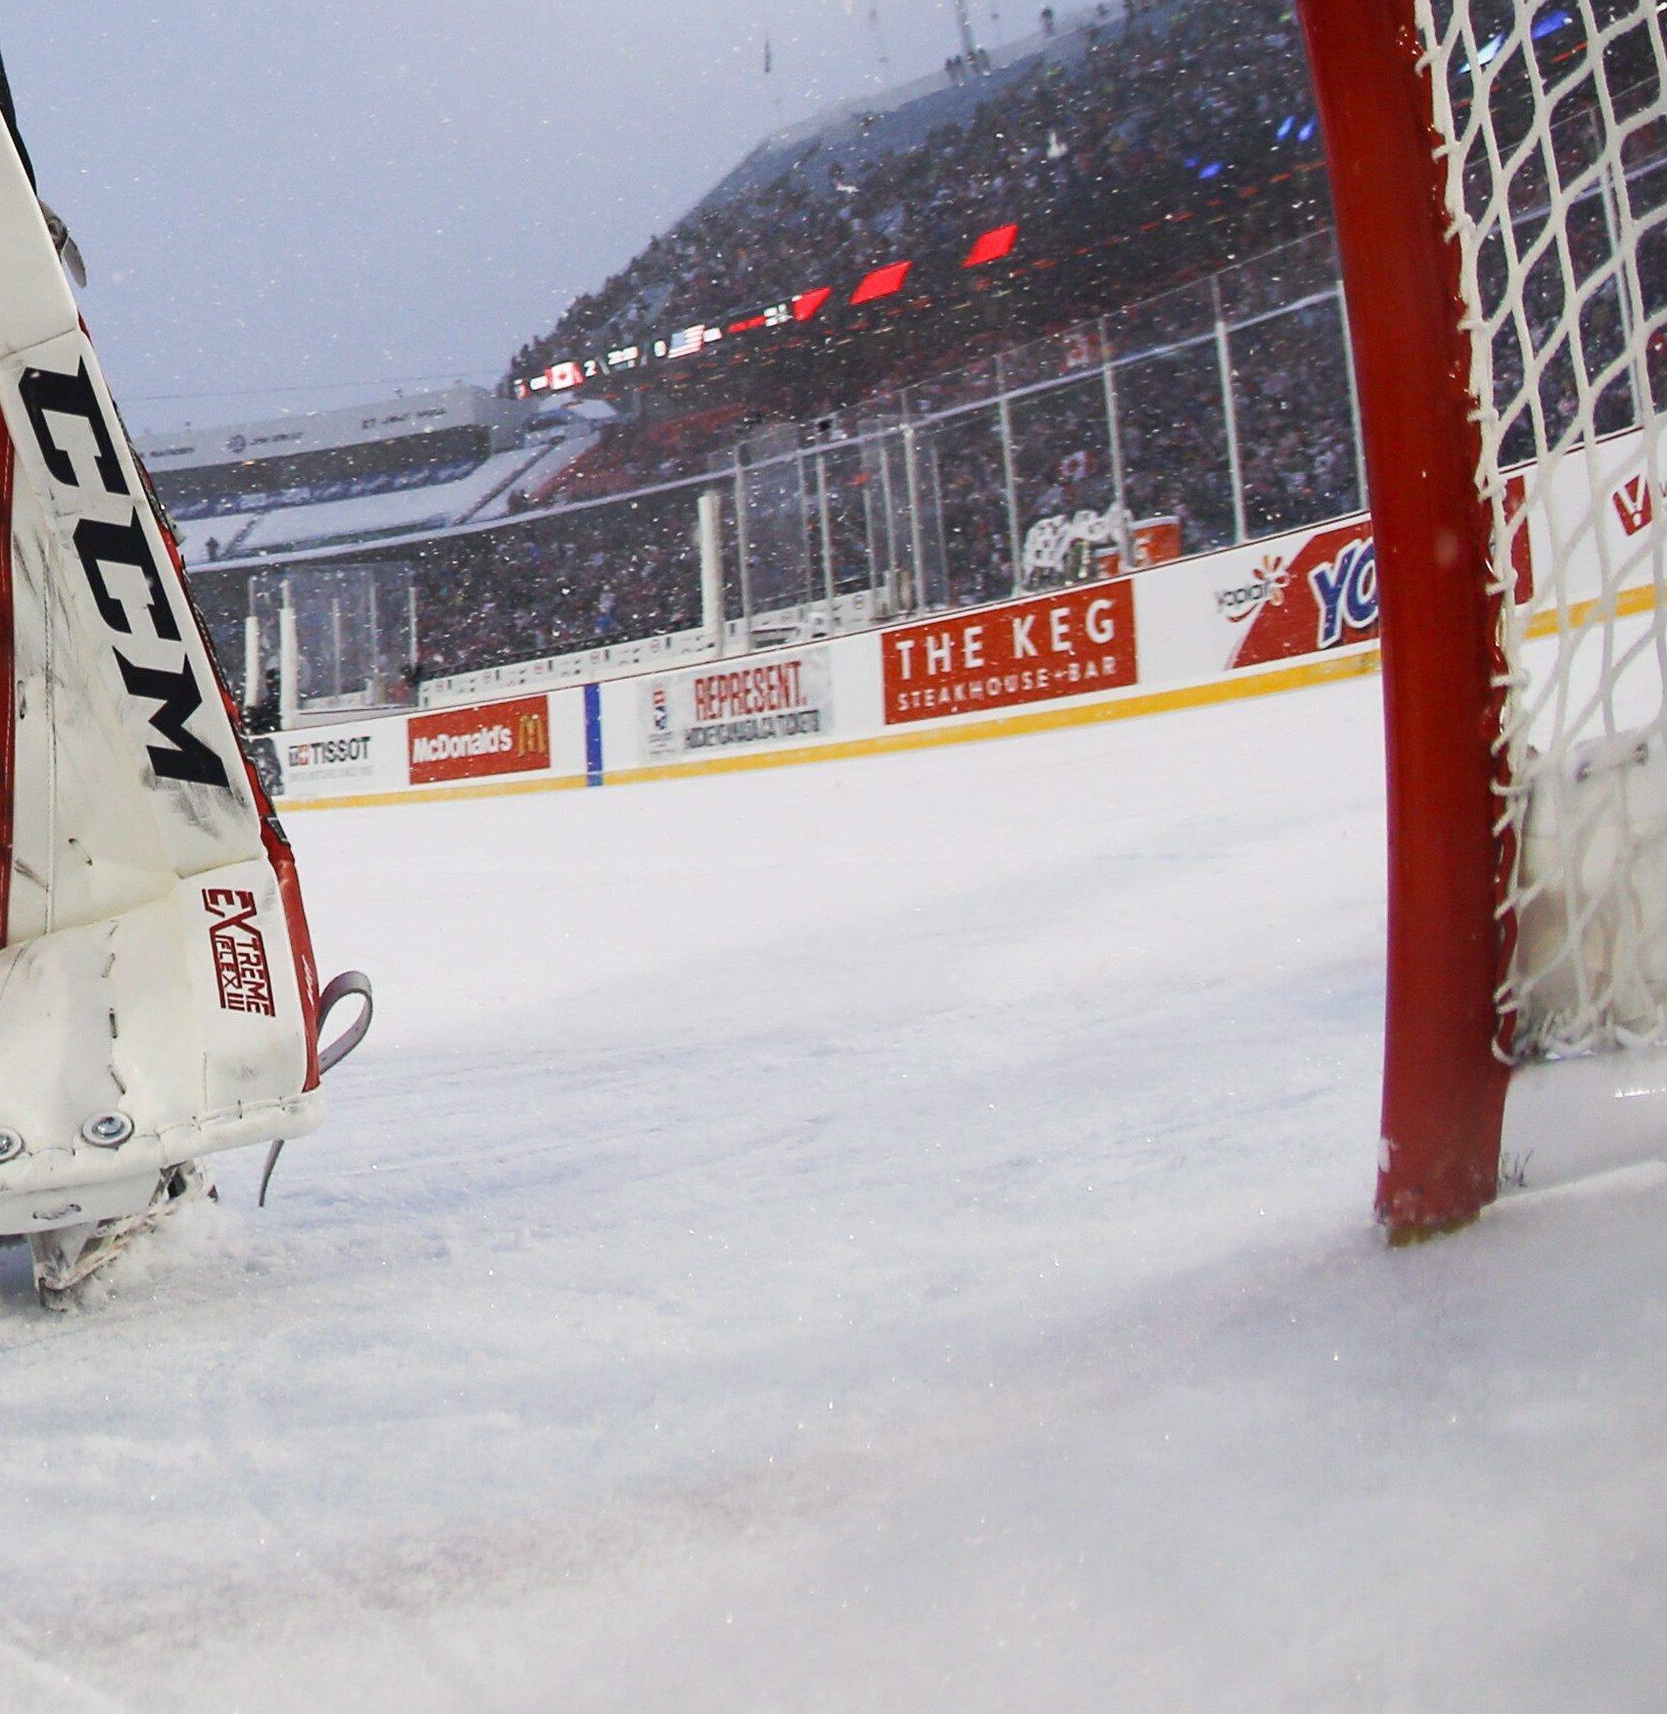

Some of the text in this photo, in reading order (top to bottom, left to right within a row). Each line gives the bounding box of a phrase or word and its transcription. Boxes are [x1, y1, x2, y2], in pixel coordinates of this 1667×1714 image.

[17, 353, 230, 787] CCM
[895, 598, 1115, 680] THE KEG
[310, 735, 372, 765] TISSOT
[412, 723, 513, 764] McDonald's
[201, 888, 276, 1018] EXTREME
